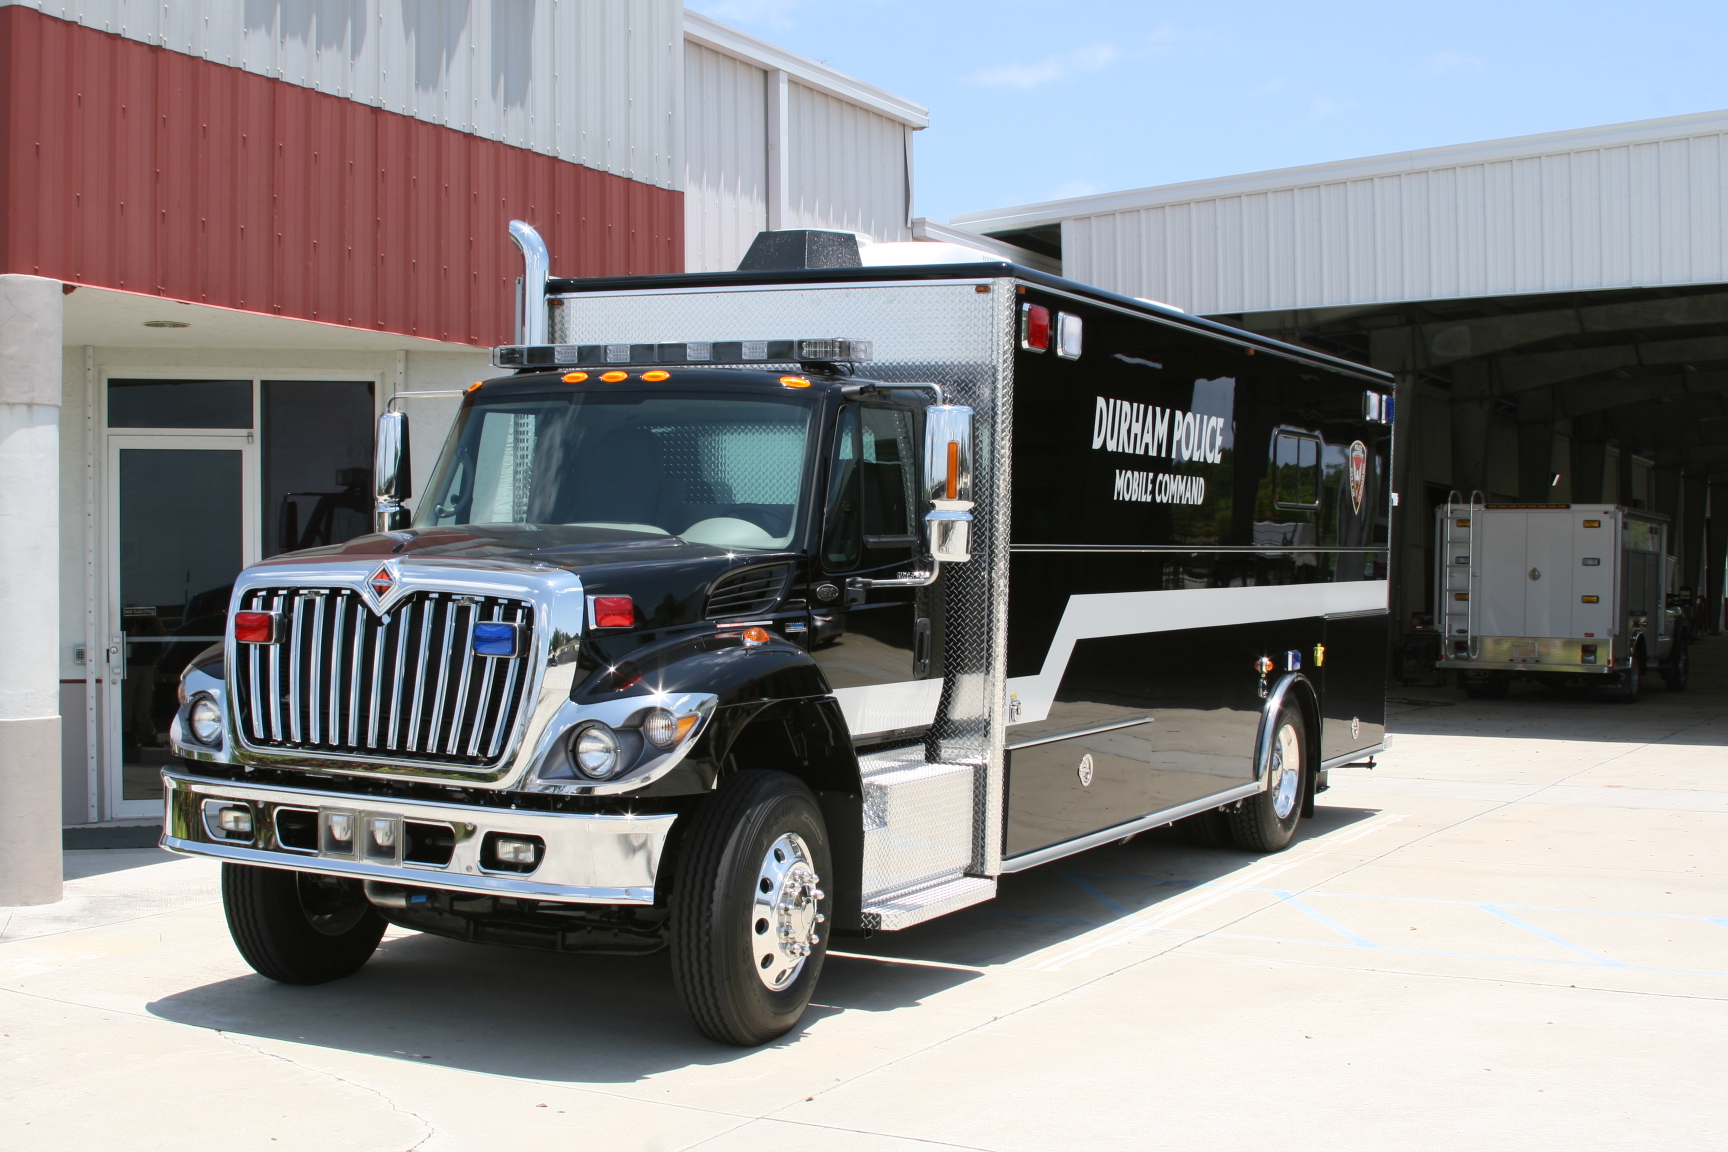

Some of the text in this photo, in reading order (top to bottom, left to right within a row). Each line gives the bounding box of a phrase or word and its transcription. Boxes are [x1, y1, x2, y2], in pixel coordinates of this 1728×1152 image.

[1092, 396, 1224, 464] DURHAM POLICE
[1114, 469, 1205, 505] MOBILE COMMAND
